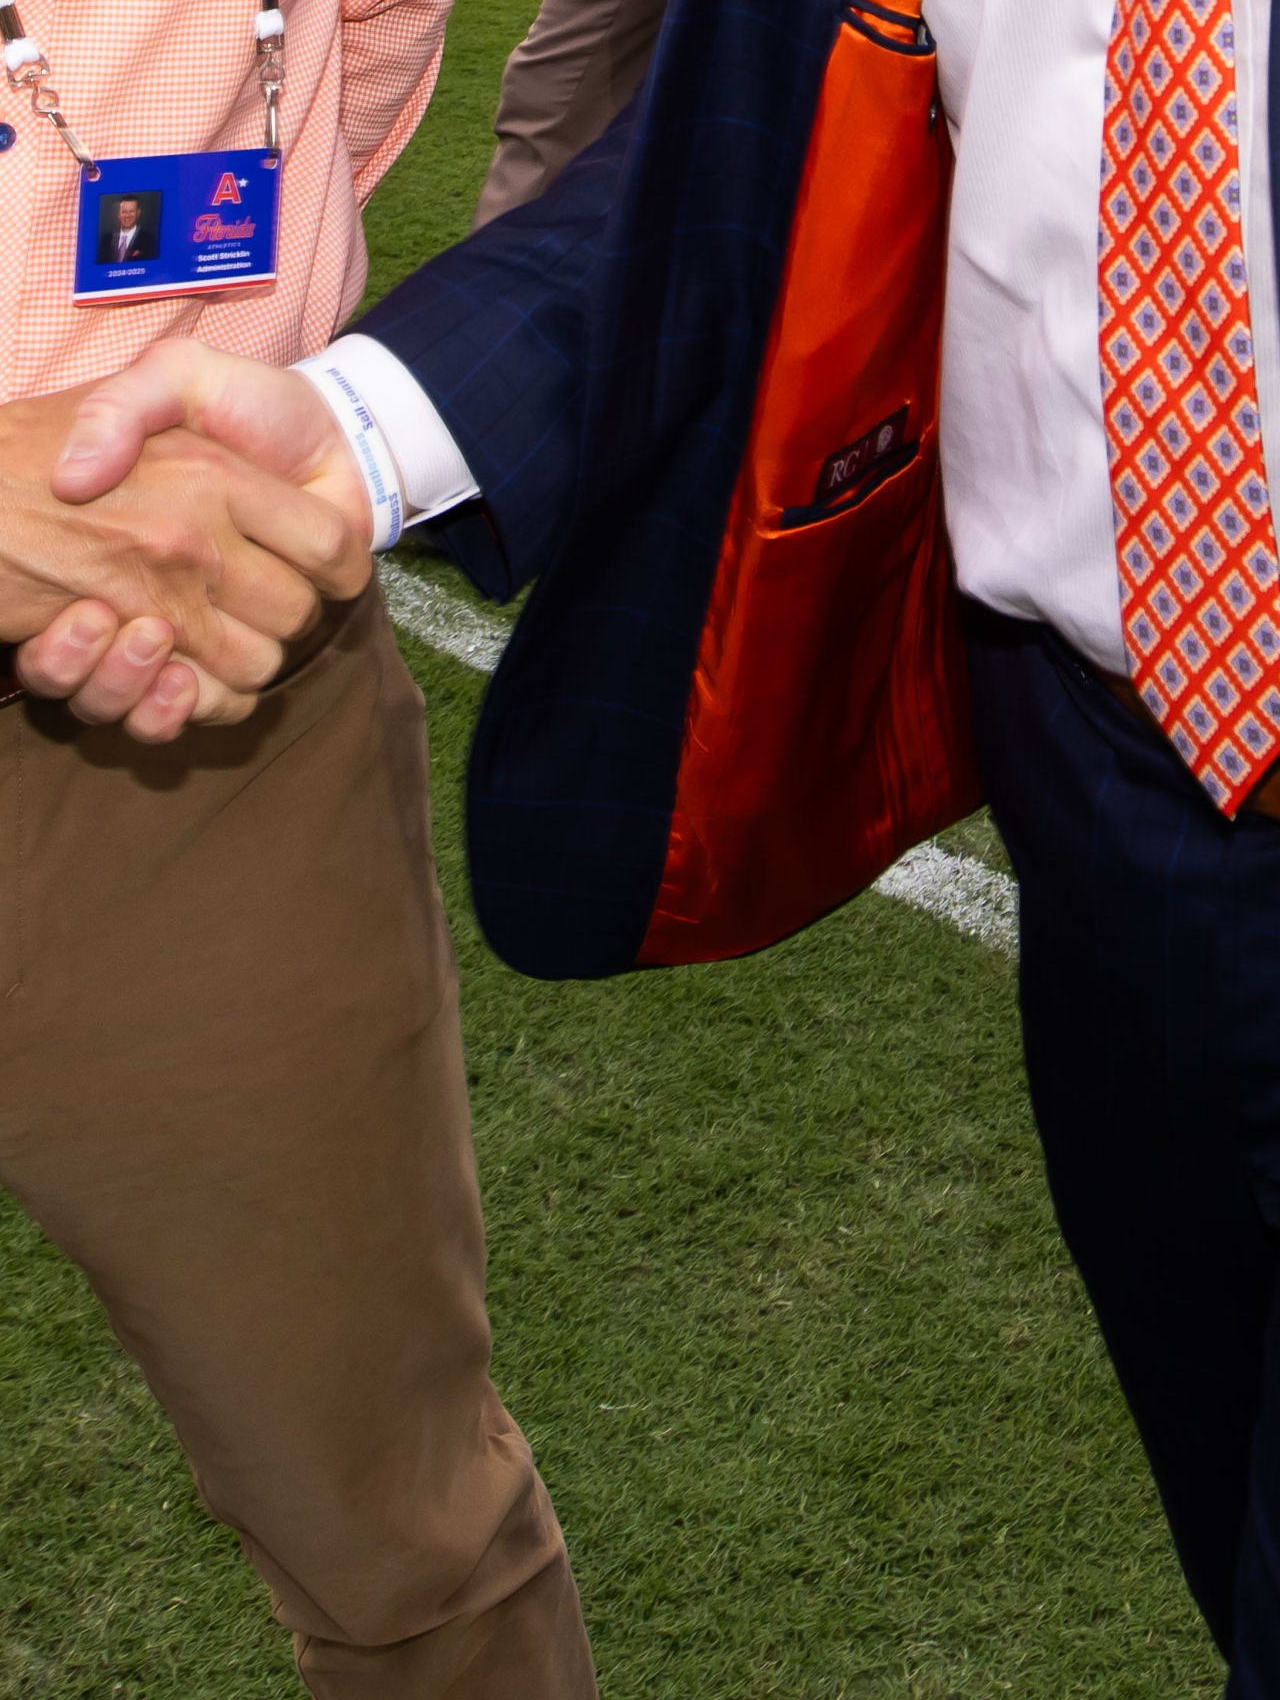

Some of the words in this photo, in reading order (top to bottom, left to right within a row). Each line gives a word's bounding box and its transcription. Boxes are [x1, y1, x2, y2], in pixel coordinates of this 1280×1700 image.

[211, 172, 242, 206] A
[193, 213, 256, 243] Florida
[197, 253, 218, 262] Scott
